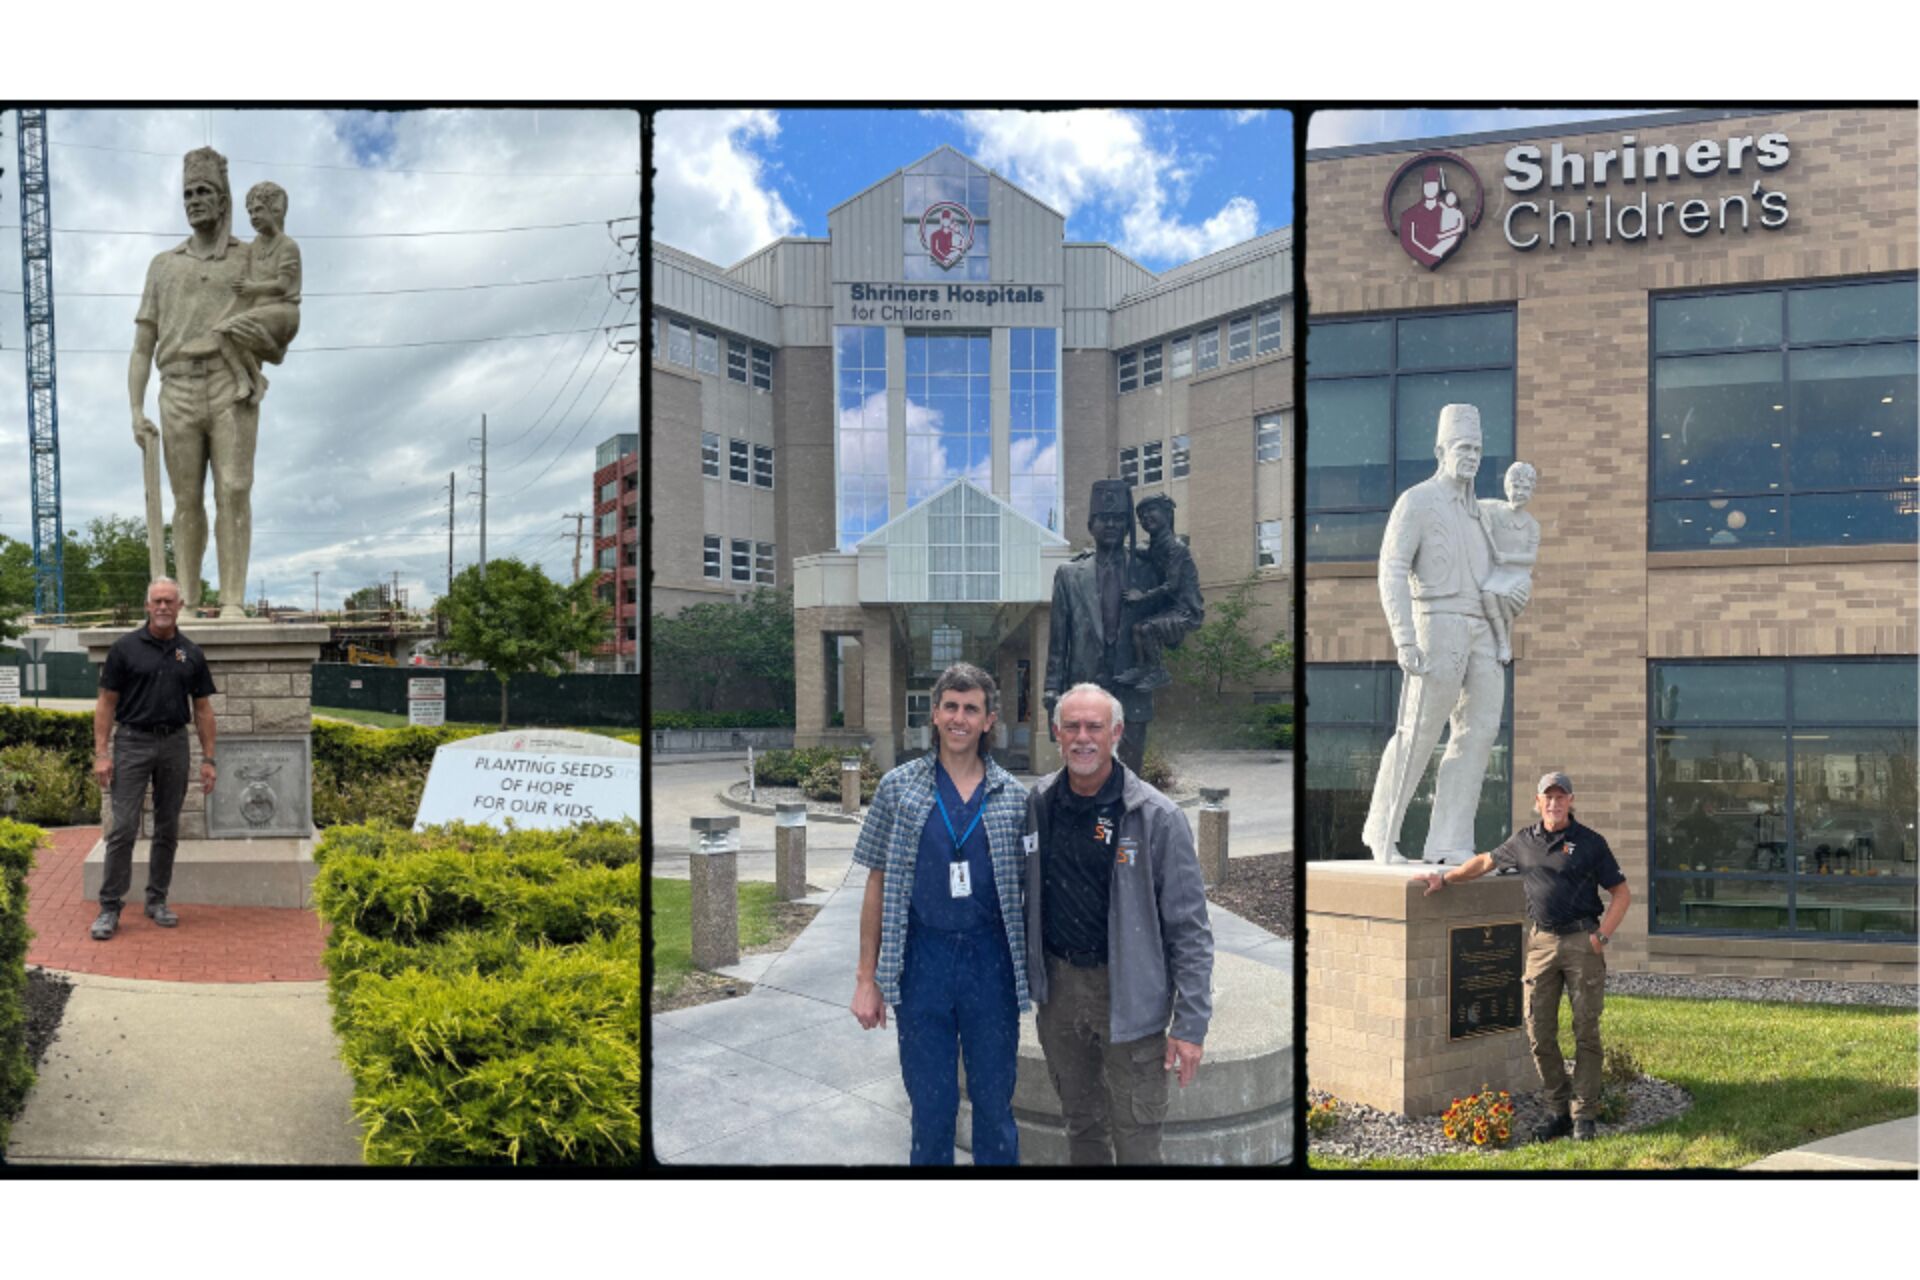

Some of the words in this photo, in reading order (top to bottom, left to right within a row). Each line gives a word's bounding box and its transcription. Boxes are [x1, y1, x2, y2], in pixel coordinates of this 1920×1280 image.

[1503, 132, 1790, 194] Shriners
[1503, 180, 1790, 249] Children's
[851, 282, 940, 301] Shriners
[947, 284, 1045, 306] Hospitals
[852, 304, 875, 320] for
[881, 305, 953, 321] Children
[475, 756, 556, 775] PLANTING
[560, 761, 614, 779] SEEDS
[500, 777, 523, 792] OF
[527, 780, 574, 797] HOPE
[473, 795, 506, 811] FOR
[510, 799, 547, 815] OUR
